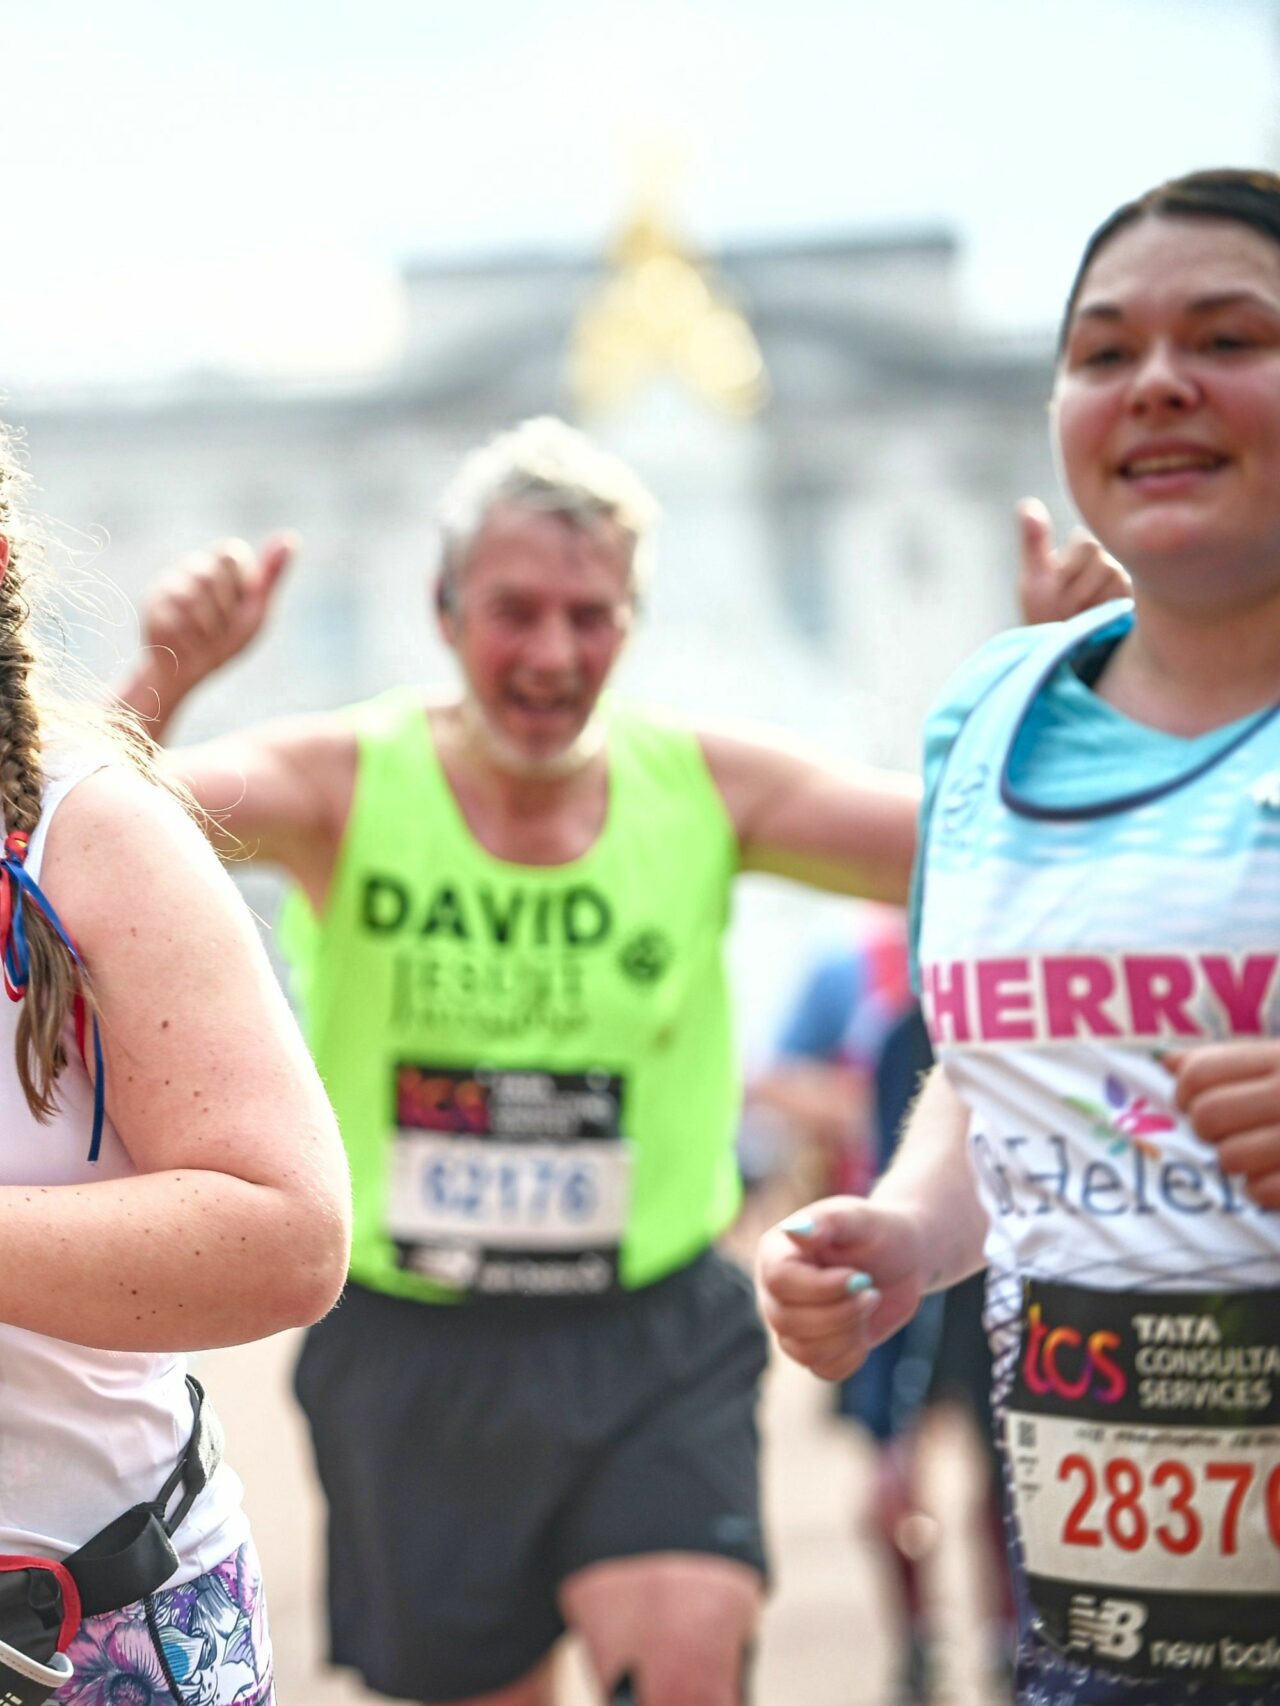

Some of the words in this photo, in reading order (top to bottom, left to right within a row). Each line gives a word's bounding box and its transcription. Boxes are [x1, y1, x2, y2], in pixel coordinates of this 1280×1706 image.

[363, 875, 612, 946] DAVID
[424, 1157, 598, 1219] 62176
[1131, 1314, 1220, 1343] TATA
[1023, 1302, 1128, 1404] tcs
[1138, 1379, 1271, 1409] SERVICES
[1150, 1638, 1217, 1669] new
